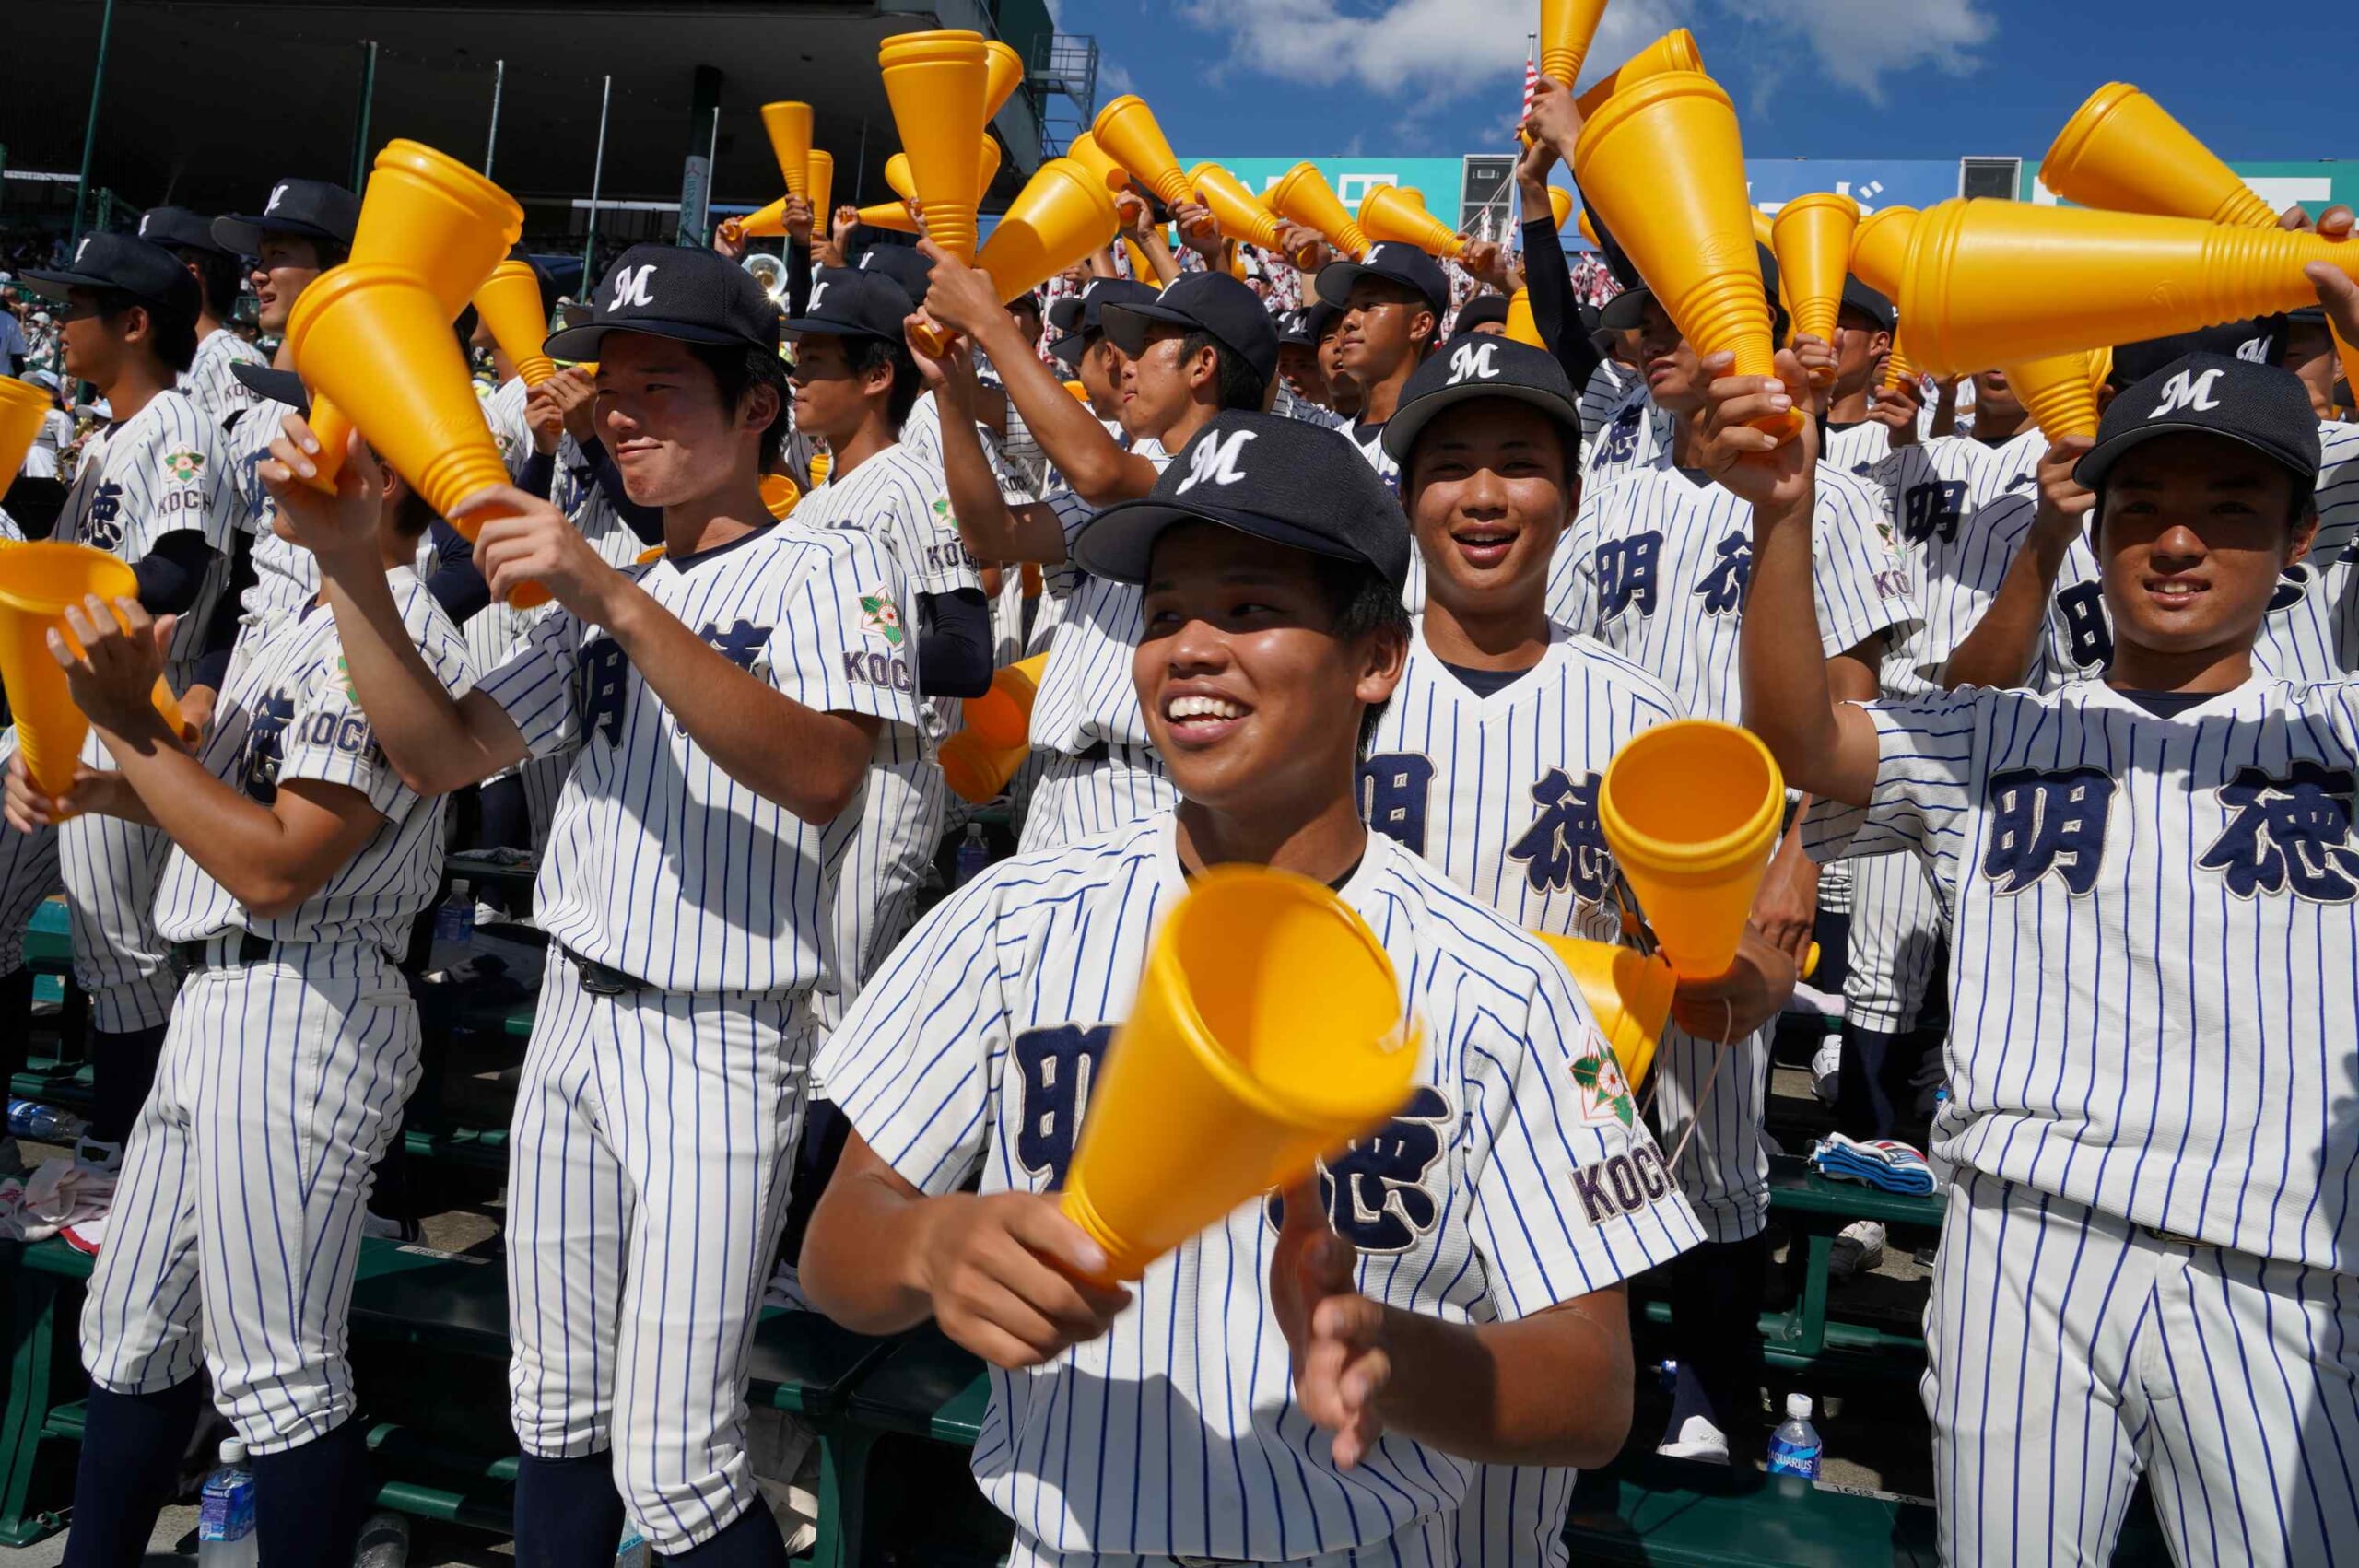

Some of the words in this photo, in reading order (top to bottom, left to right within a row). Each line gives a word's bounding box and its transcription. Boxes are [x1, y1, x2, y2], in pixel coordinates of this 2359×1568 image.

[607, 264, 658, 313] M
[1449, 342, 1500, 386] M
[2146, 368, 2225, 420] M
[1175, 428, 1259, 496] M
[925, 541, 980, 570] KOC
[1770, 1450, 1813, 1471] AQUARIUS
